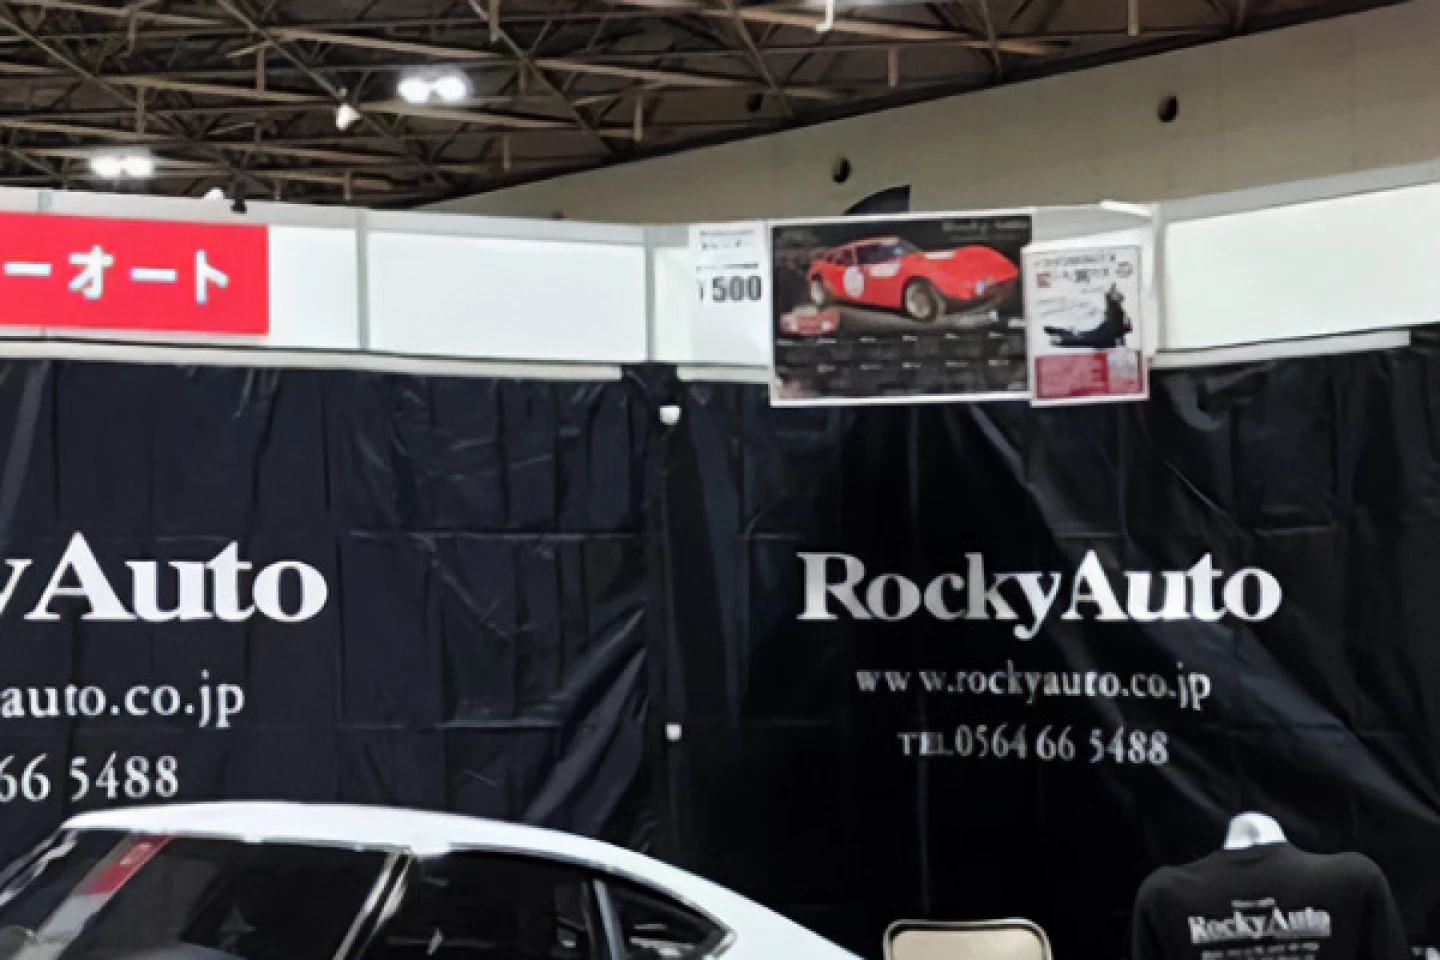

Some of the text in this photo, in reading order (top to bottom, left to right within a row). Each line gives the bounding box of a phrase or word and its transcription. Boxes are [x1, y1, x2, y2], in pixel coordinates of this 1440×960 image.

[797, 549, 1283, 640] RockyAuto
[1035, 726, 1076, 761] 66
[1088, 725, 1170, 765] 5488
[68, 752, 180, 800] 5488
[1187, 905, 1332, 945] RockyAuto
